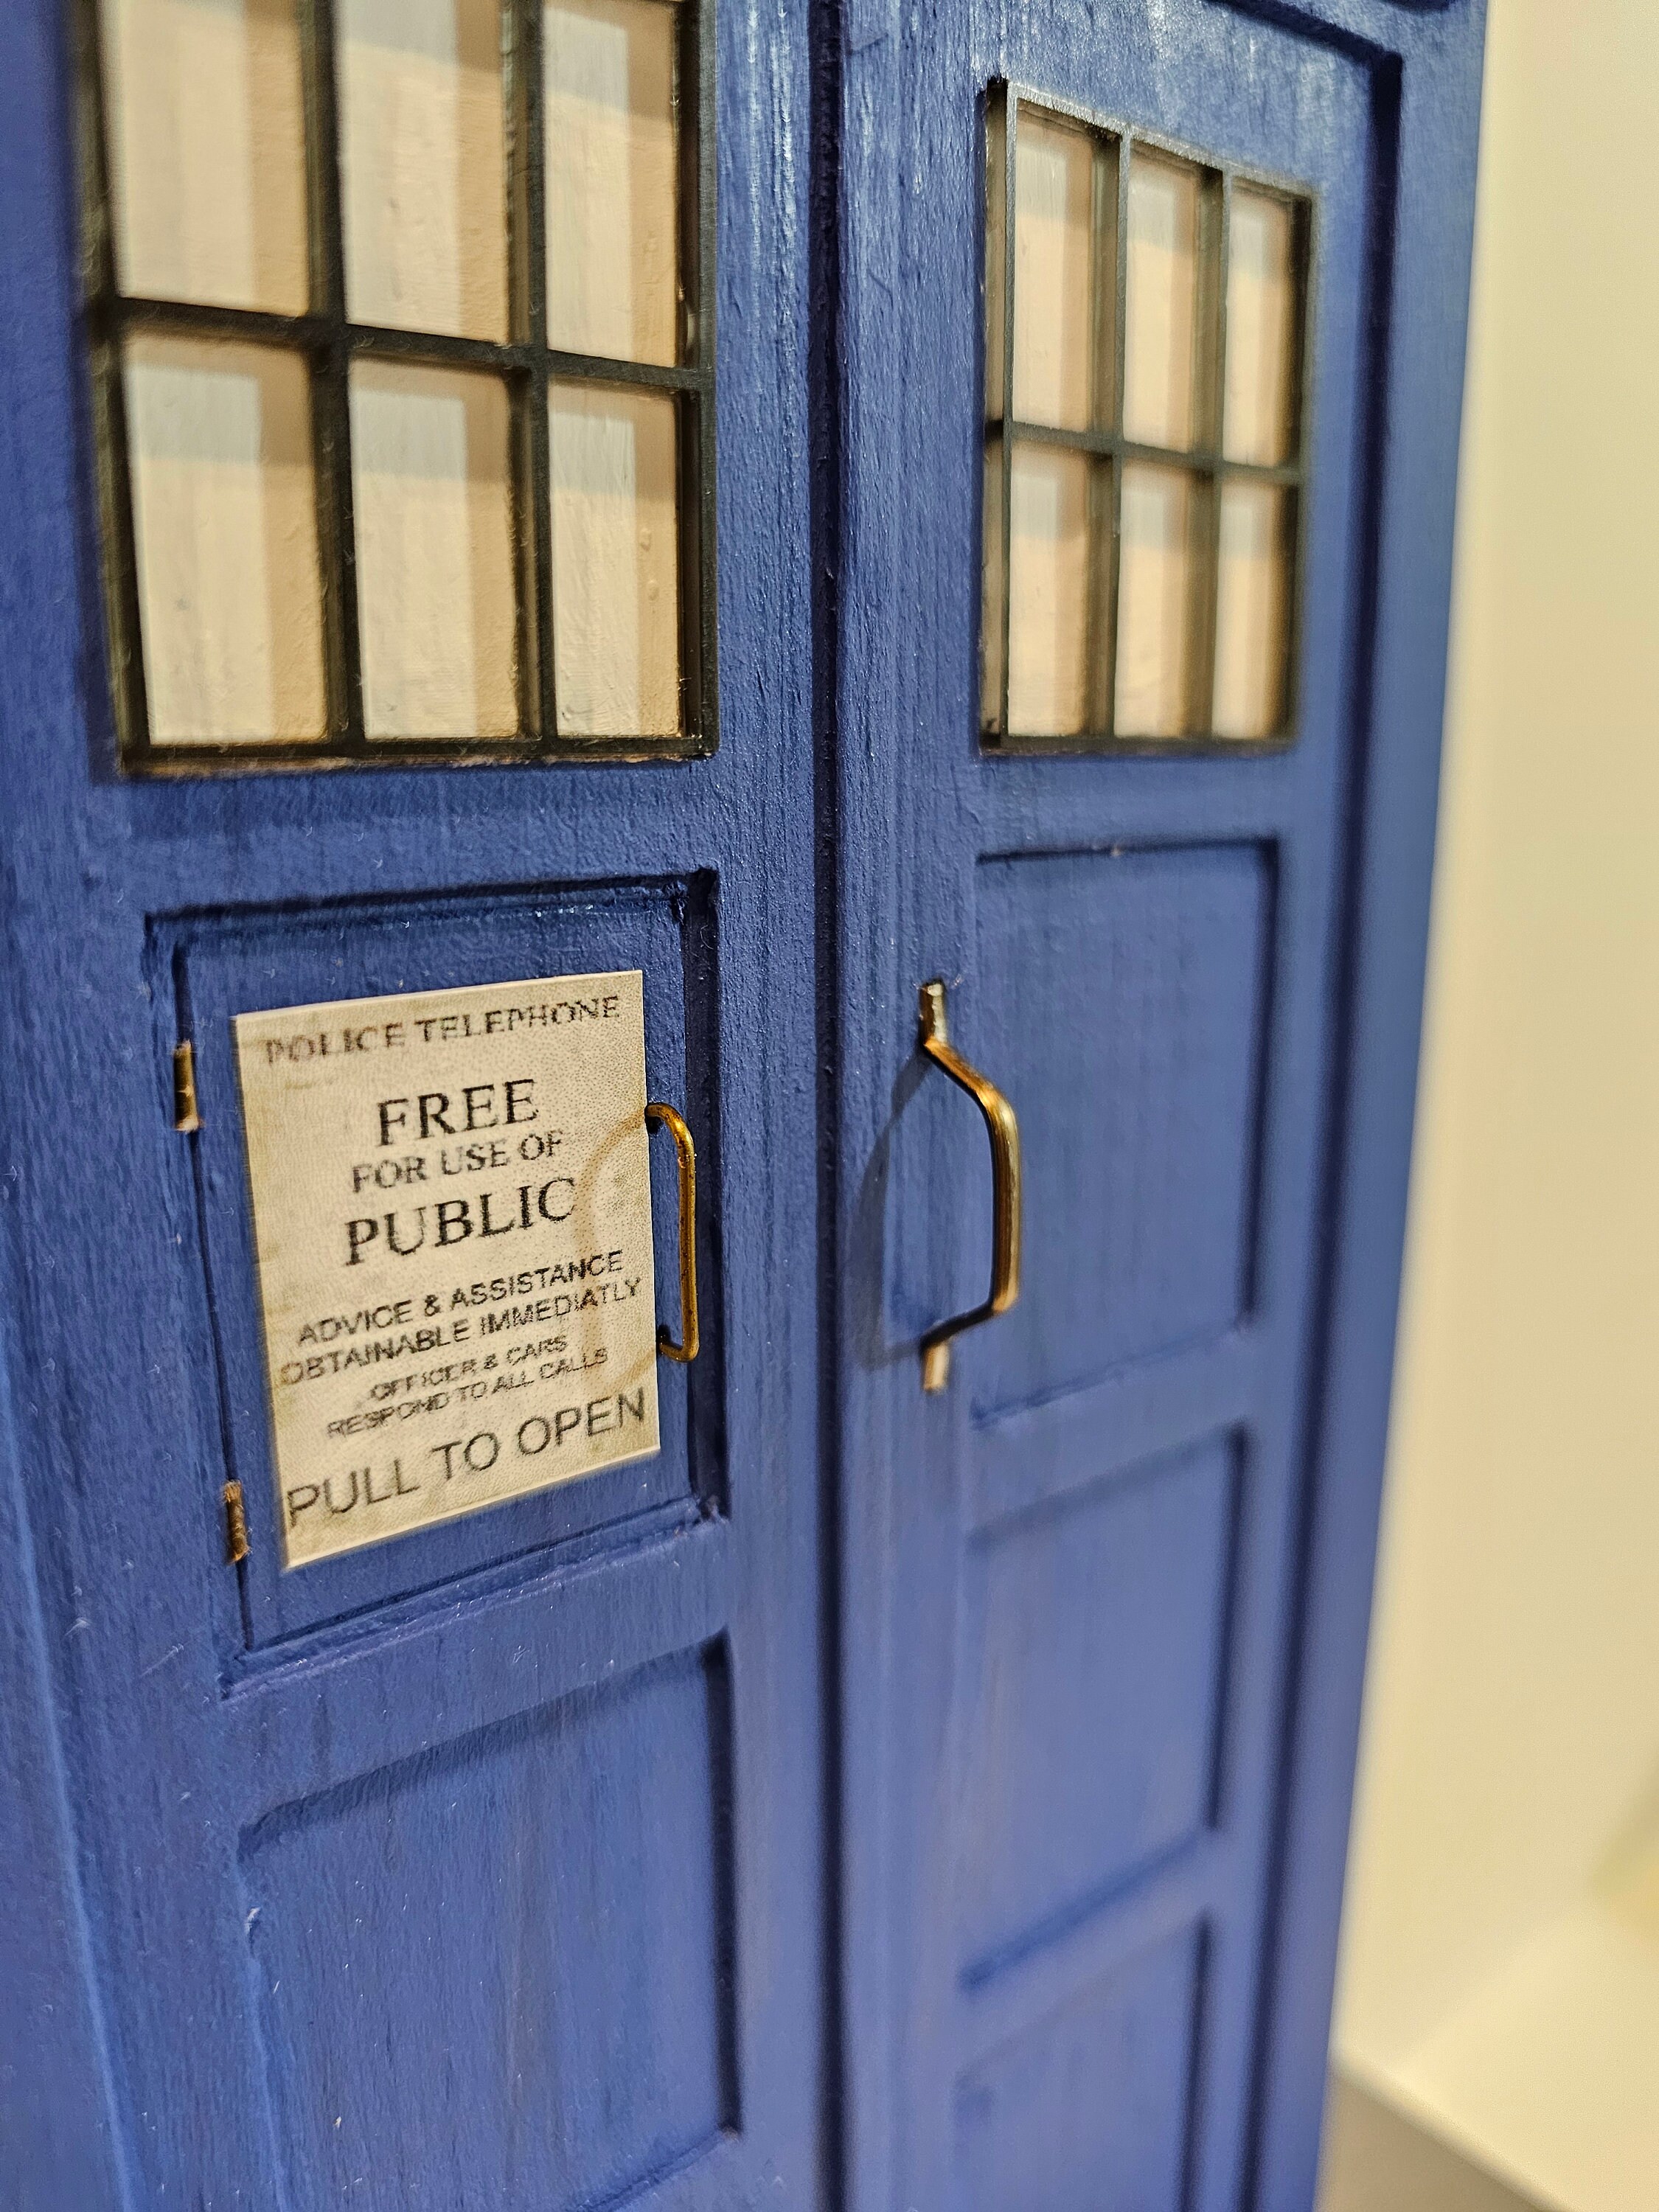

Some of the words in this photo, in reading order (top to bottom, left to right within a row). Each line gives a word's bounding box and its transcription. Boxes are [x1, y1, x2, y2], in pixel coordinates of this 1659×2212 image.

[264, 1021, 406, 1065] POLICE
[414, 995, 621, 1043] TELEPHONE
[377, 1078, 540, 1146] FREE
[351, 1155, 428, 1194] FOR
[439, 1138, 510, 1176] USE
[518, 1129, 564, 1162] OF
[344, 1177, 577, 1267] PUBLIC
[280, 1319, 471, 1385] OBTAINABLE
[480, 1276, 642, 1338] IMMEDIATLY
[297, 1300, 414, 1347] ADVICE
[423, 1294, 443, 1318] &
[451, 1250, 625, 1308] ASSISTANCE
[327, 1394, 452, 1438] RESPOND
[455, 1382, 489, 1403] TO
[493, 1368, 535, 1394] ALL
[539, 1346, 610, 1380] CALLS
[484, 1352, 498, 1369] &
[507, 1334, 568, 1365] CARS
[286, 1458, 420, 1528] PULL
[431, 1432, 501, 1481] TO
[516, 1386, 647, 1456] OPEN
